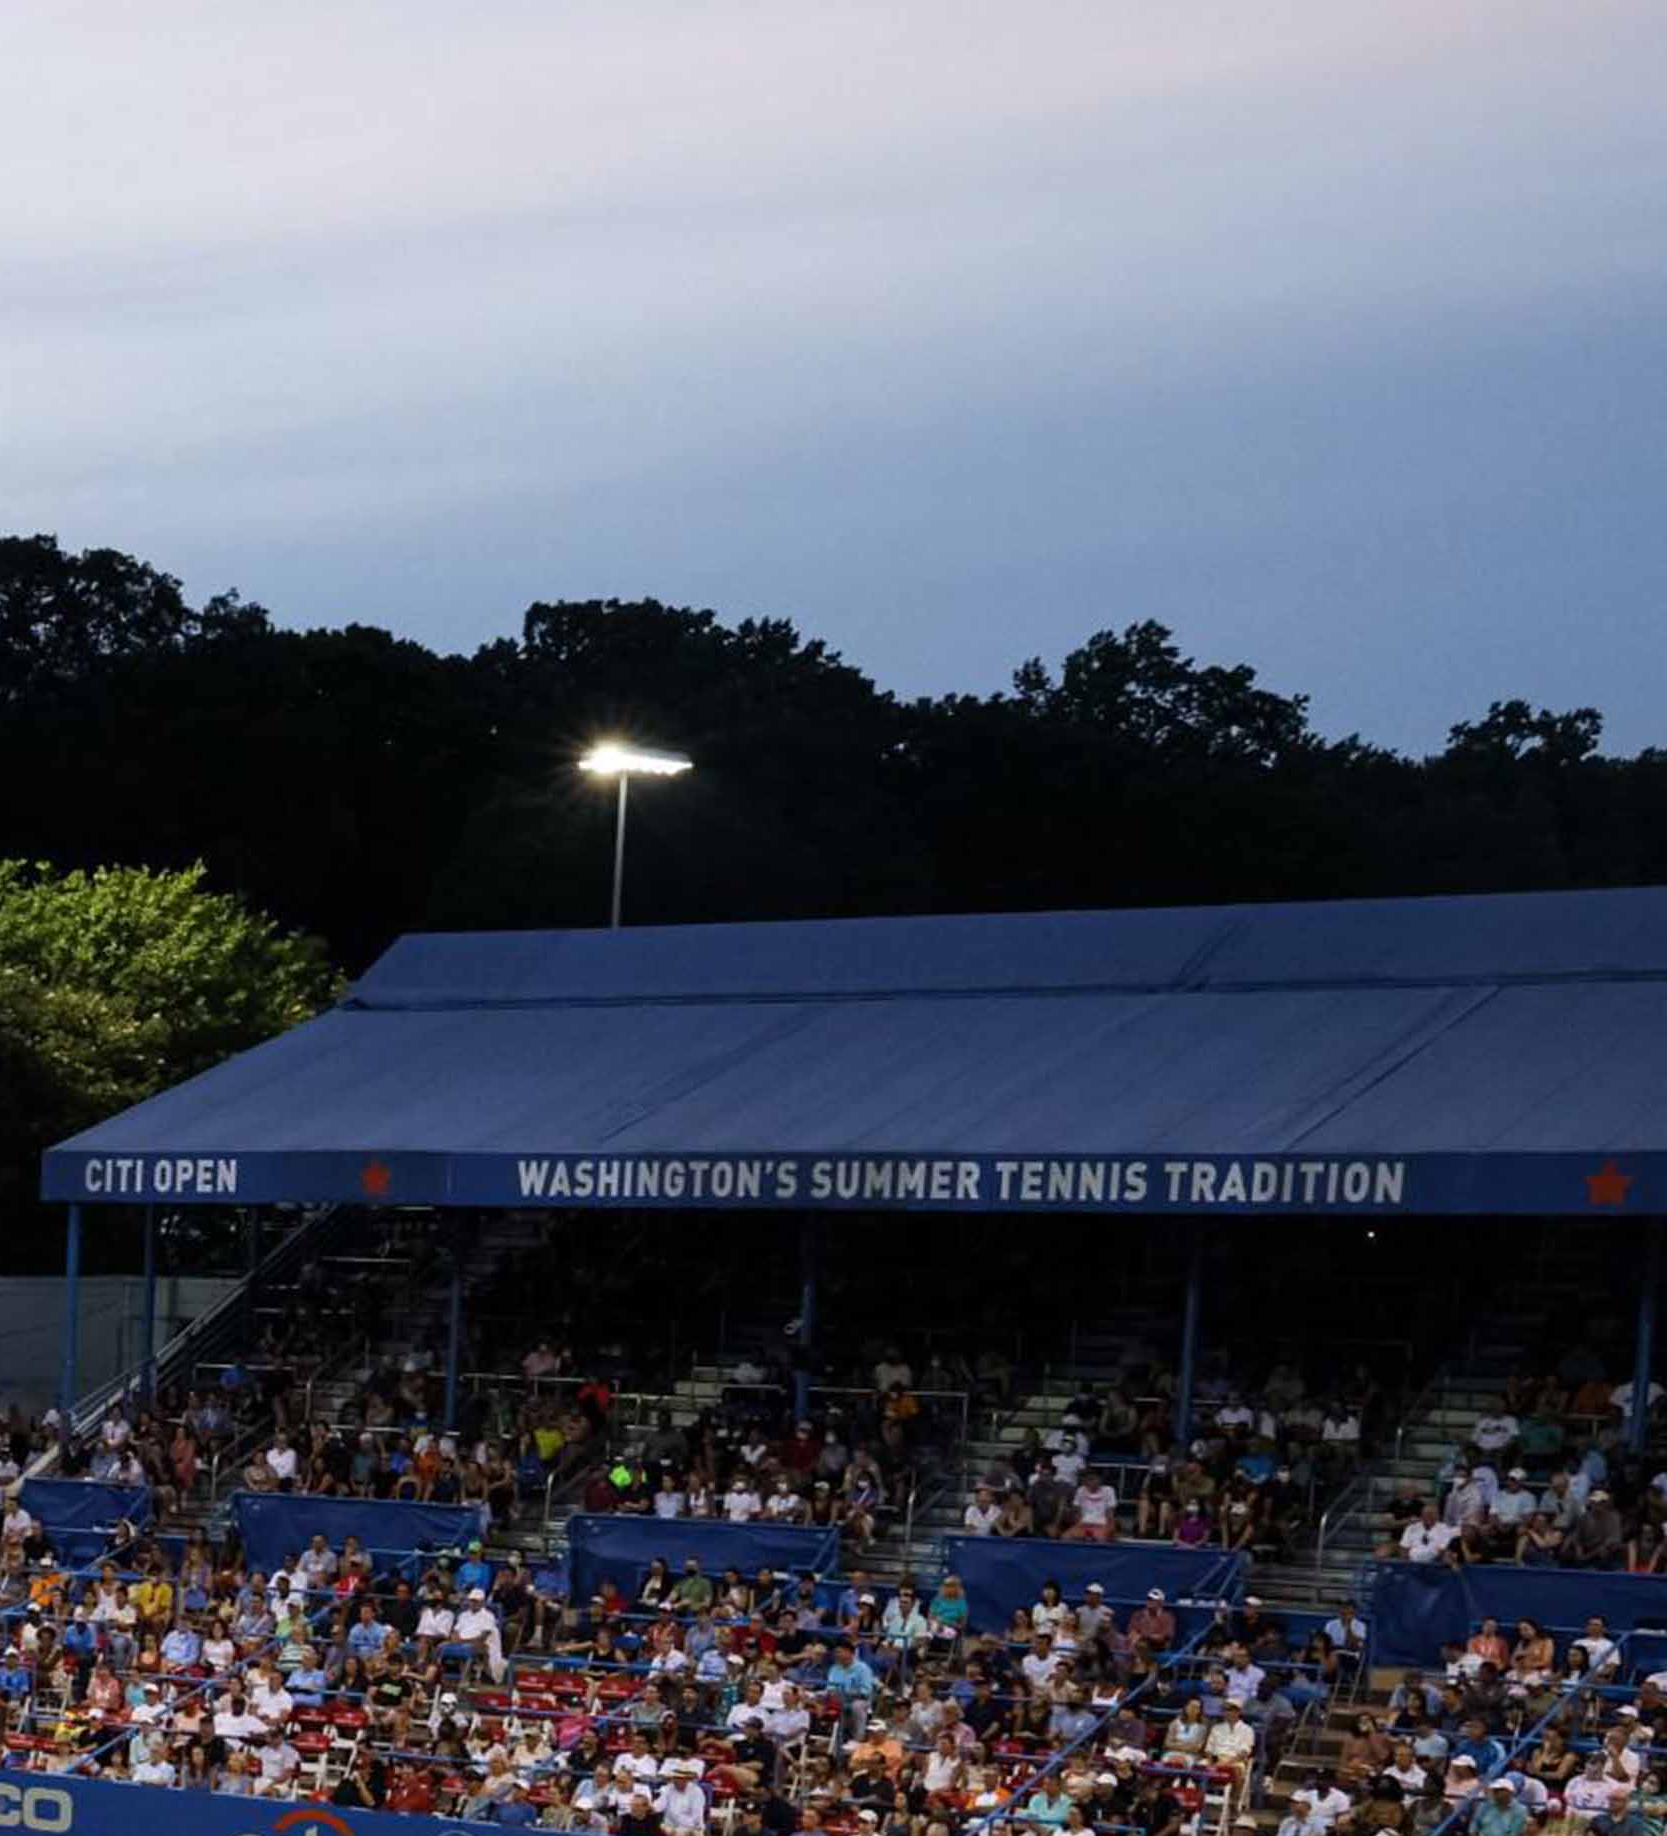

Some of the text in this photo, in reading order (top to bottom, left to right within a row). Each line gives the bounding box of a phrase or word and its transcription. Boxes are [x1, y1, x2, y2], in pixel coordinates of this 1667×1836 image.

[85, 1159, 238, 1193] CITI OPEN
[517, 1159, 1406, 1204] WASHINGTON'S SUMMER TENNIS TRADITION
